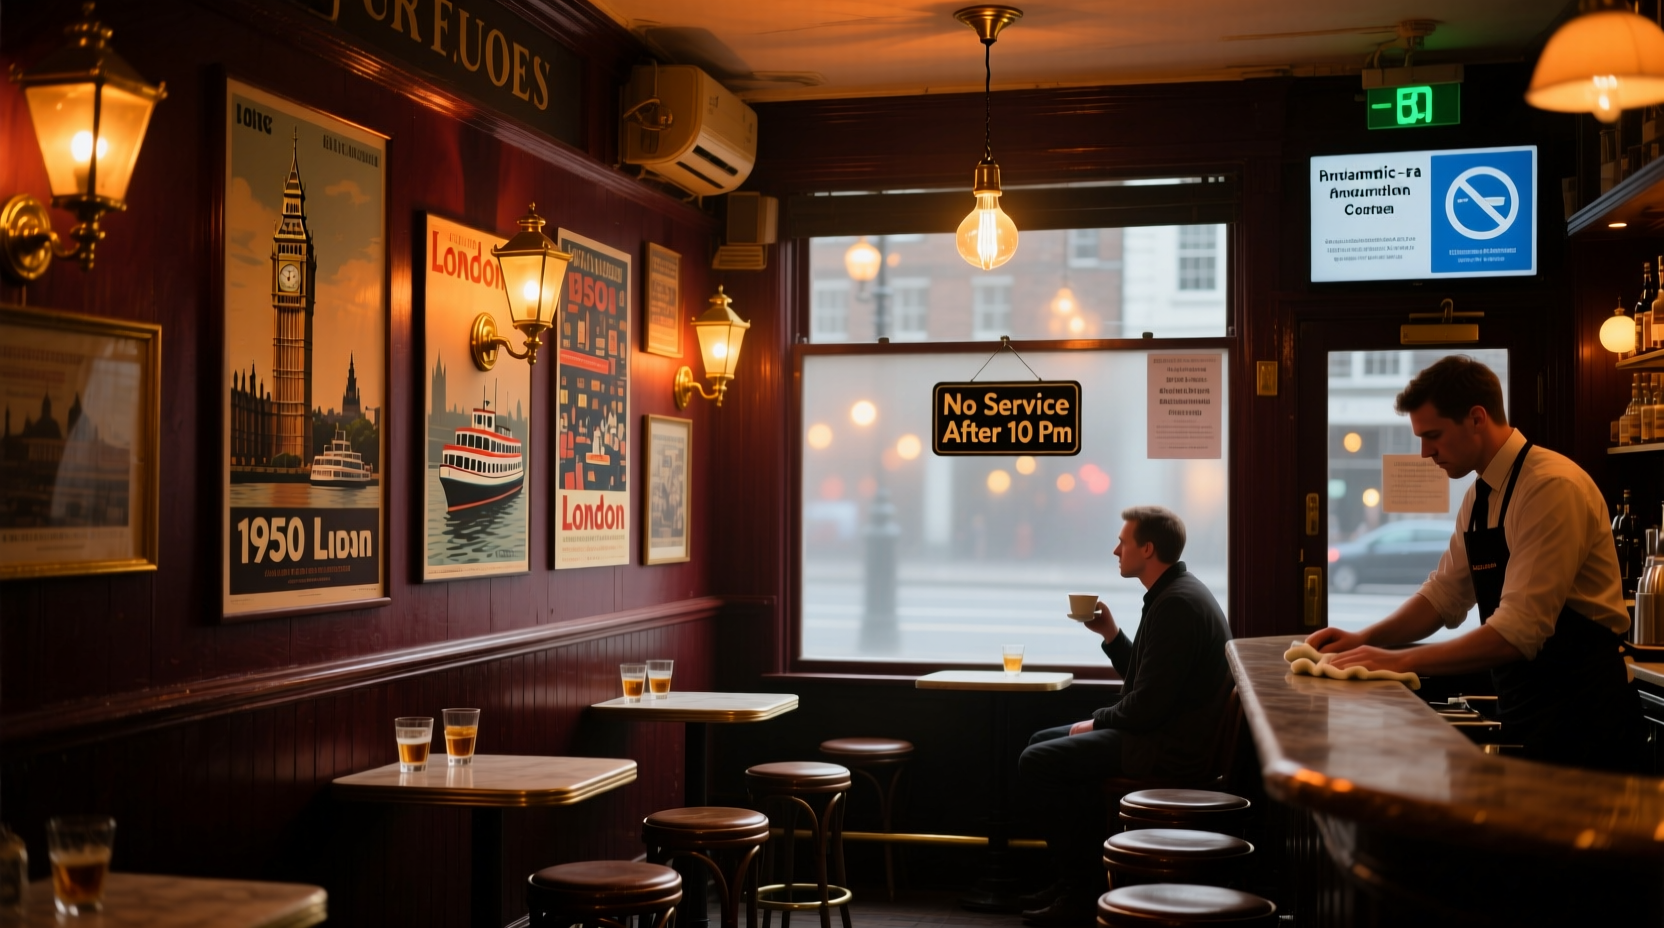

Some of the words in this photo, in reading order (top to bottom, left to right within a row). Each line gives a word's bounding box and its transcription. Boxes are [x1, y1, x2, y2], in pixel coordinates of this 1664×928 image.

[943, 393, 977, 416] No
[983, 392, 1070, 416] Service
[942, 420, 1002, 443] After
[1007, 420, 1033, 443] 10
[1039, 420, 1072, 443] Pm
[562, 494, 625, 531] London
[237, 516, 305, 564] 1950
